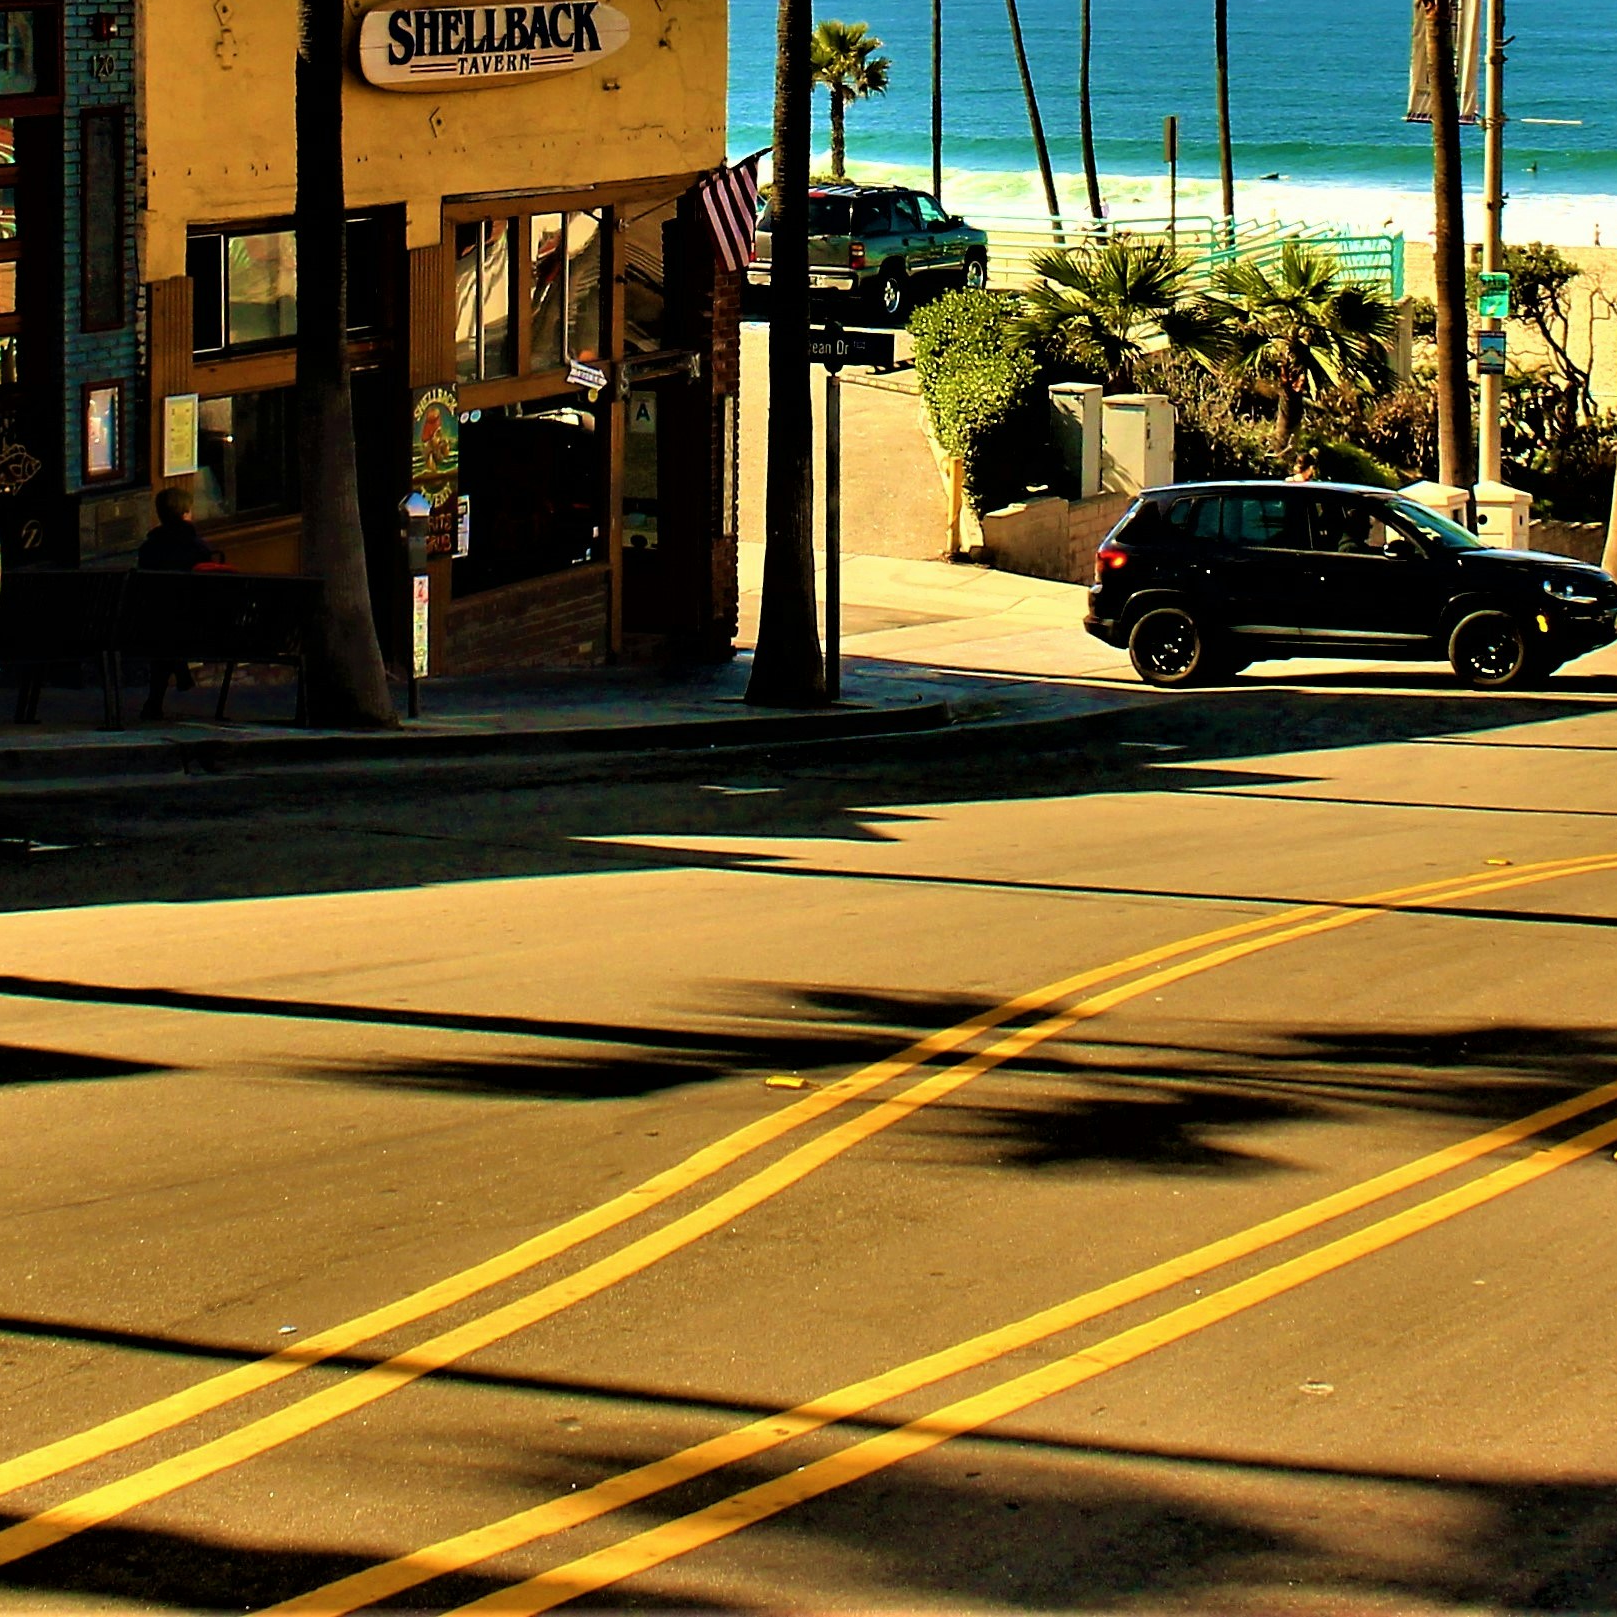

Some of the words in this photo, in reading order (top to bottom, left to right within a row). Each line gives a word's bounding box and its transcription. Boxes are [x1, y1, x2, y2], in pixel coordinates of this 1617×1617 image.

[387, 0, 602, 67] SHELLBACK
[457, 52, 532, 76] TAVERN
[809, 341, 831, 354] ean
[836, 339, 850, 355] Dr
[636, 402, 651, 422] A
[428, 513, 452, 531] RITS
